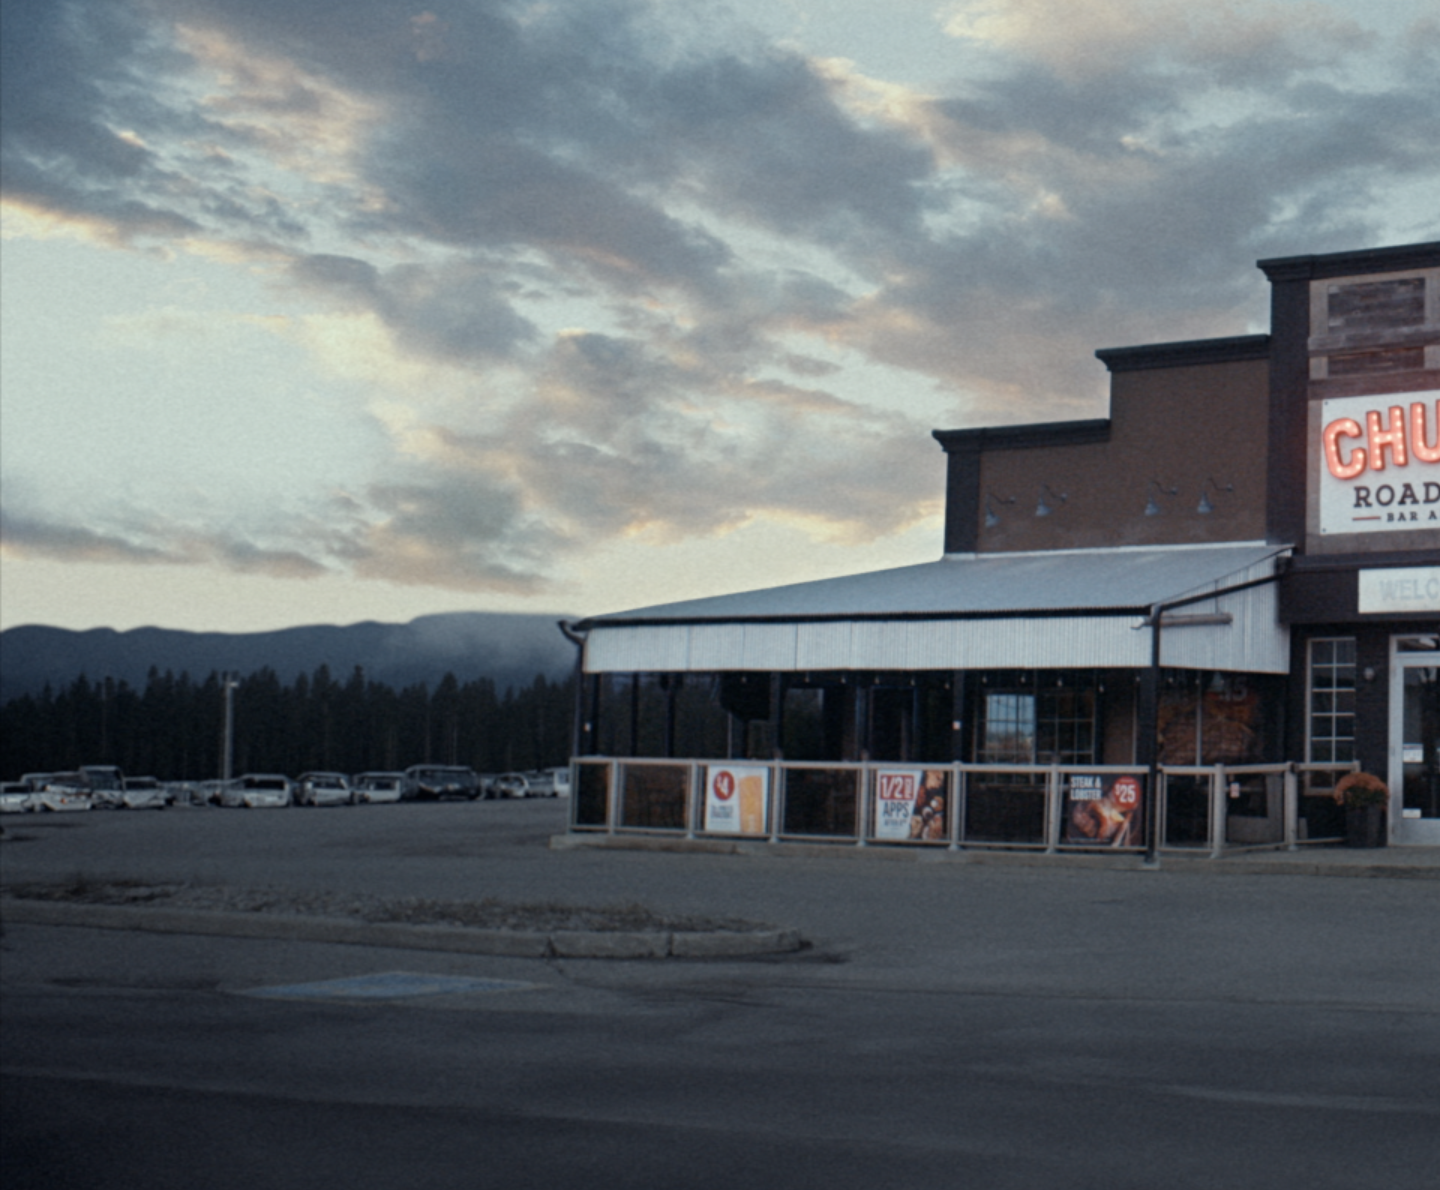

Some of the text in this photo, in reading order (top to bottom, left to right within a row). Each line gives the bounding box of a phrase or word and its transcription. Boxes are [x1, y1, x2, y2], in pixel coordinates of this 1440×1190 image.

[1387, 511, 1418, 523] BAR
[881, 775, 904, 799] 1/2
[1114, 783, 1136, 804] $25
[882, 801, 910, 818] APPS
